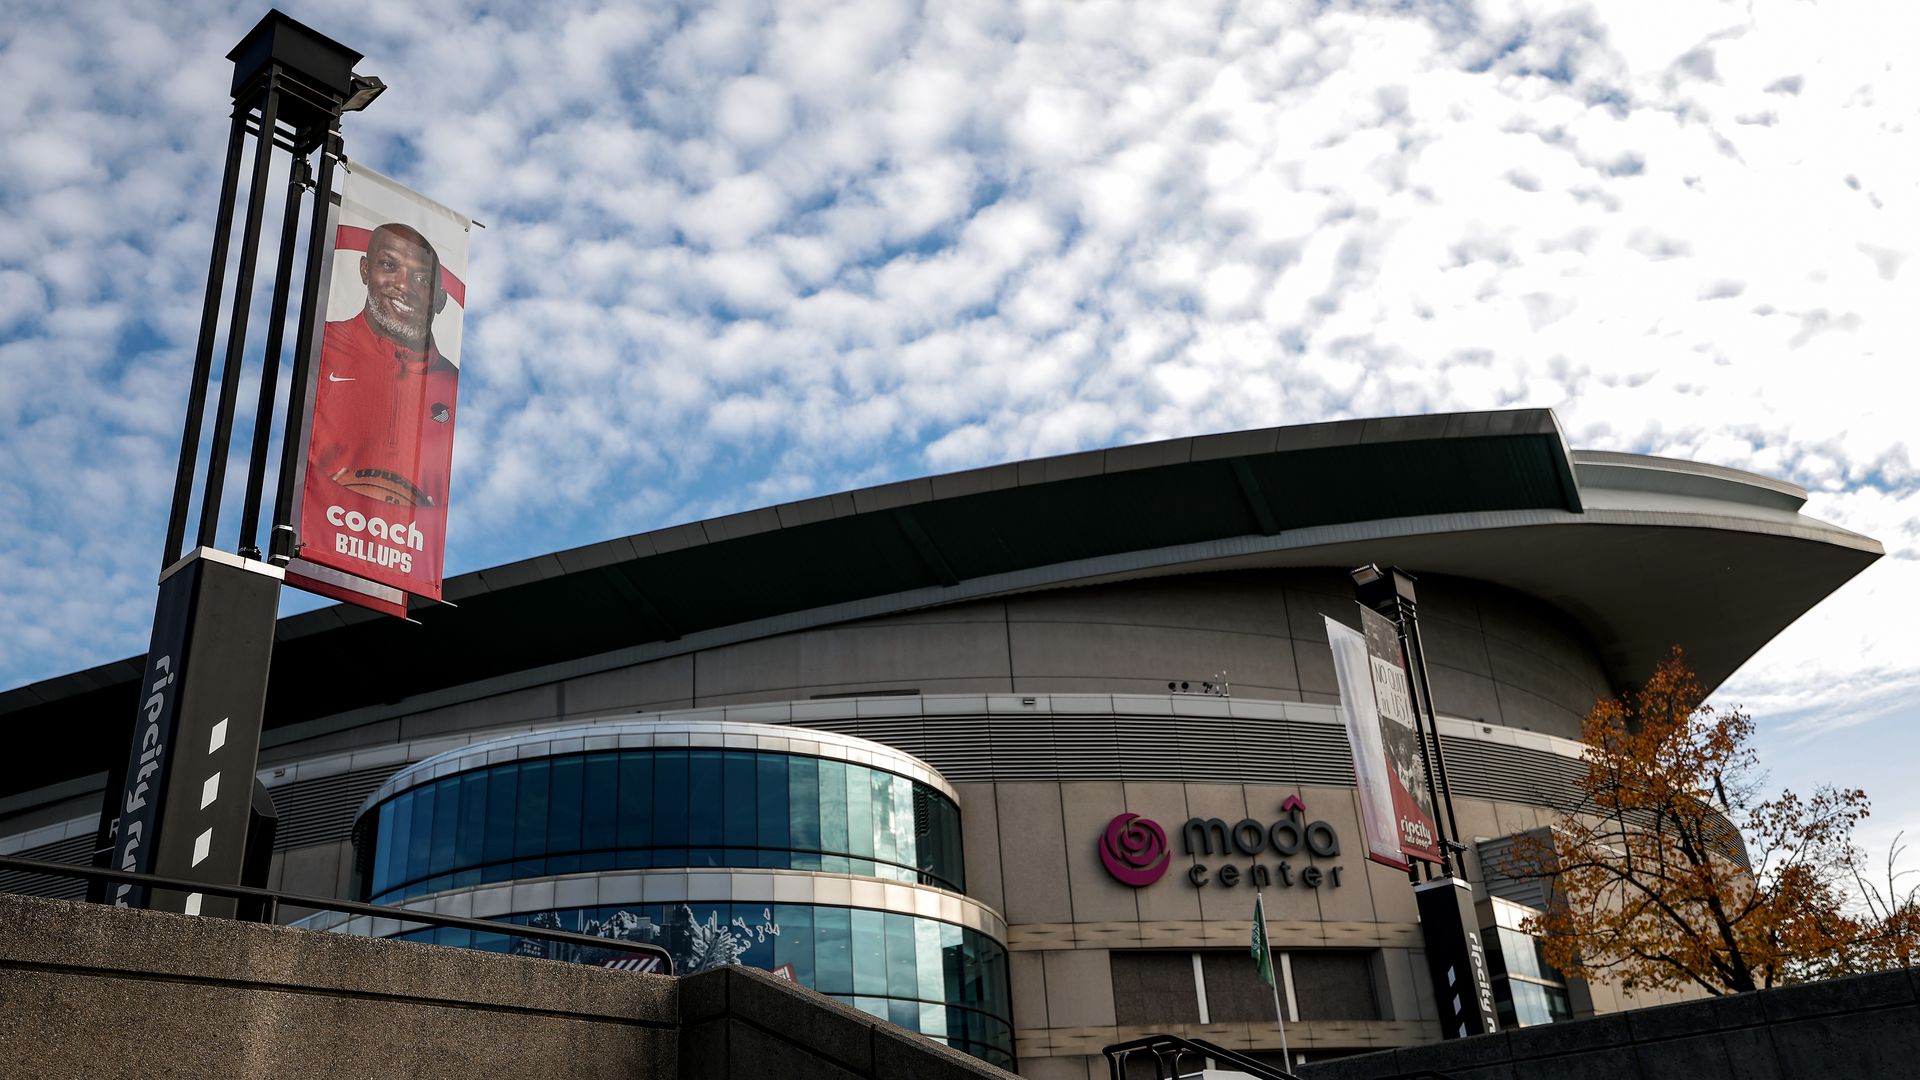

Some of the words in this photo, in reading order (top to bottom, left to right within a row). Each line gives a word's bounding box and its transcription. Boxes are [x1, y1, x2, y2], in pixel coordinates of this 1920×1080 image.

[326, 505, 424, 552] coach
[335, 532, 413, 574] BILLUPS
[1374, 661, 1387, 685] NO
[1183, 795, 1341, 857] moda
[1188, 860, 1344, 888] center
